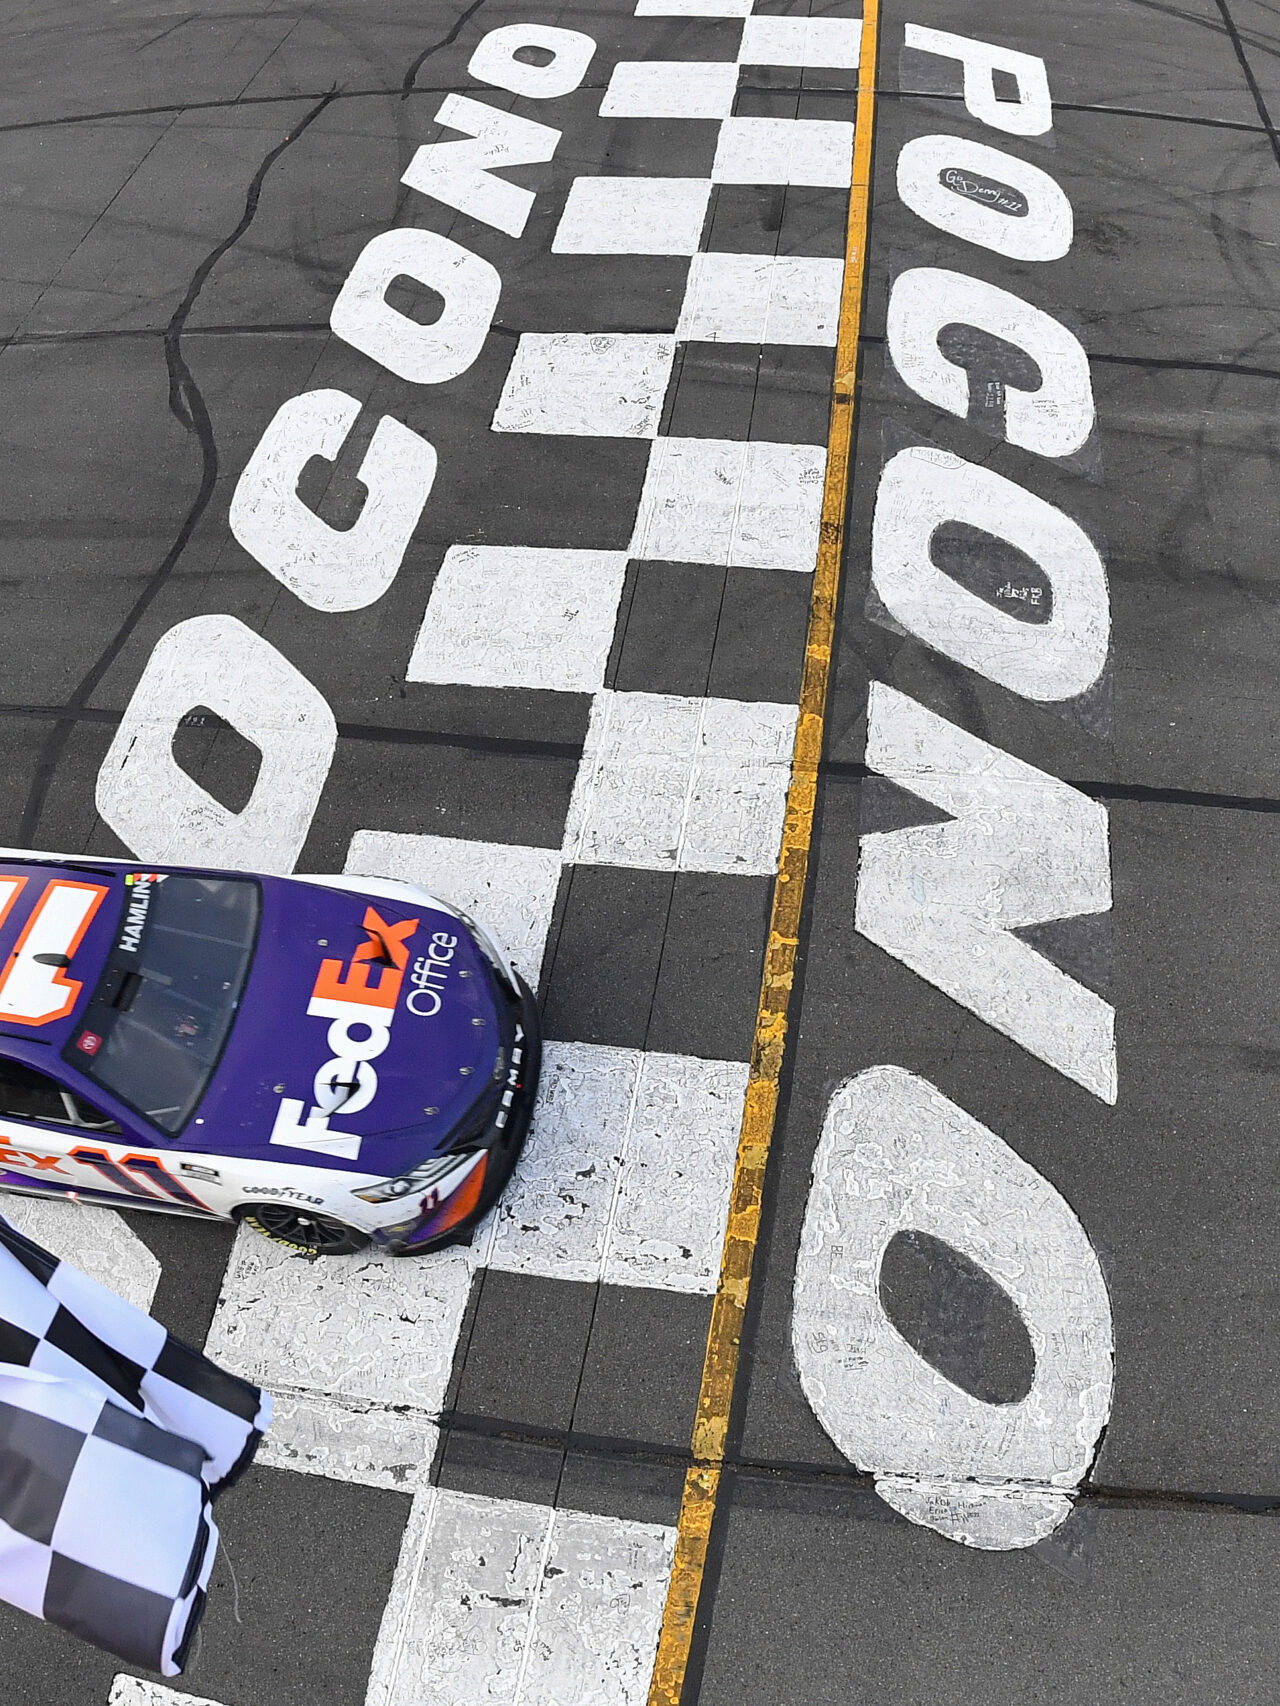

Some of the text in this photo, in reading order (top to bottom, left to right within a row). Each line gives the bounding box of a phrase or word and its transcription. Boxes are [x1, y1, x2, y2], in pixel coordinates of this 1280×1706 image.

[793, 22, 1118, 1550] POCONO
[118, 881, 152, 953] HAMLIN
[405, 931, 458, 1017] Office
[268, 905, 420, 1161] FedEx
[66, 1144, 217, 1213] 11
[242, 1186, 325, 1206] GOODYEAR
